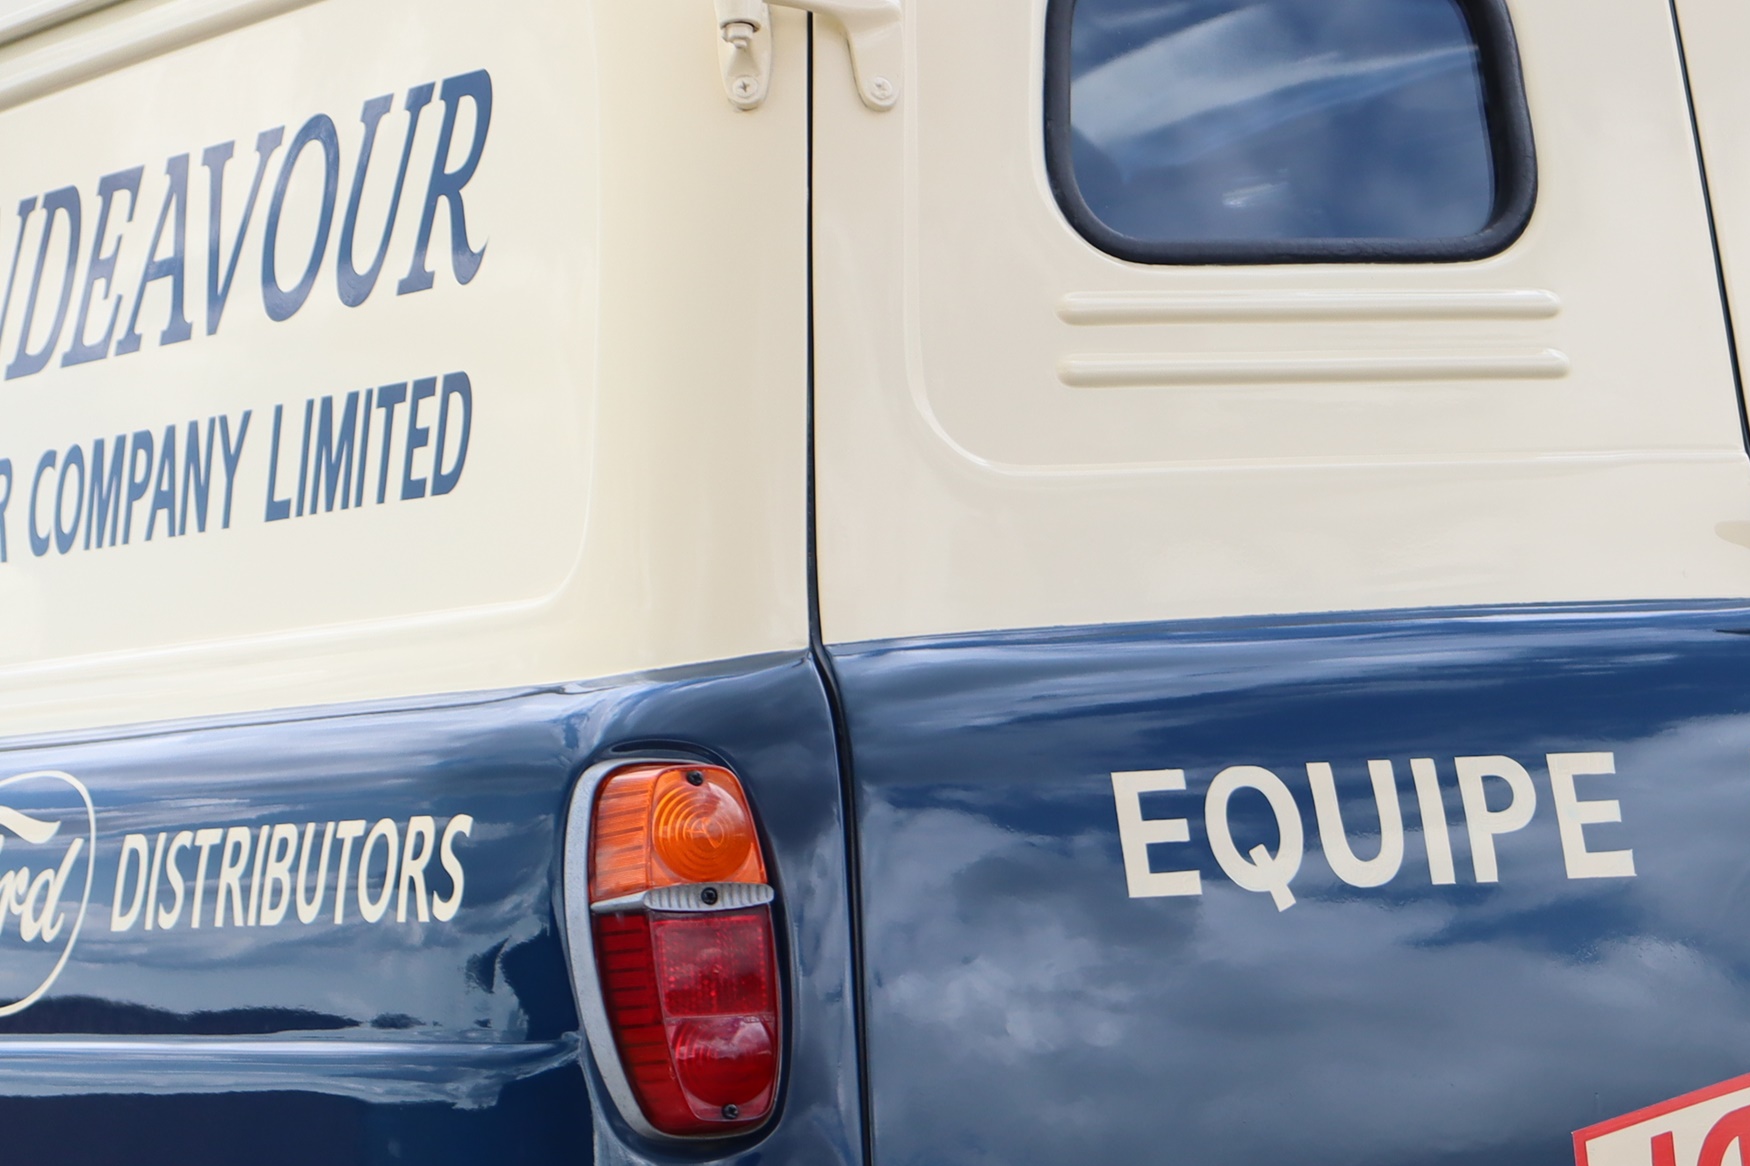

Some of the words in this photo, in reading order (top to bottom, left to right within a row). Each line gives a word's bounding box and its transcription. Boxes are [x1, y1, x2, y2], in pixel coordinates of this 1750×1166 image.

[28, 408, 252, 557] COMPANY
[264, 371, 472, 522] LIMITED
[110, 815, 472, 931] DISTRIBUTORS
[1111, 752, 1634, 910] EQUIPE
